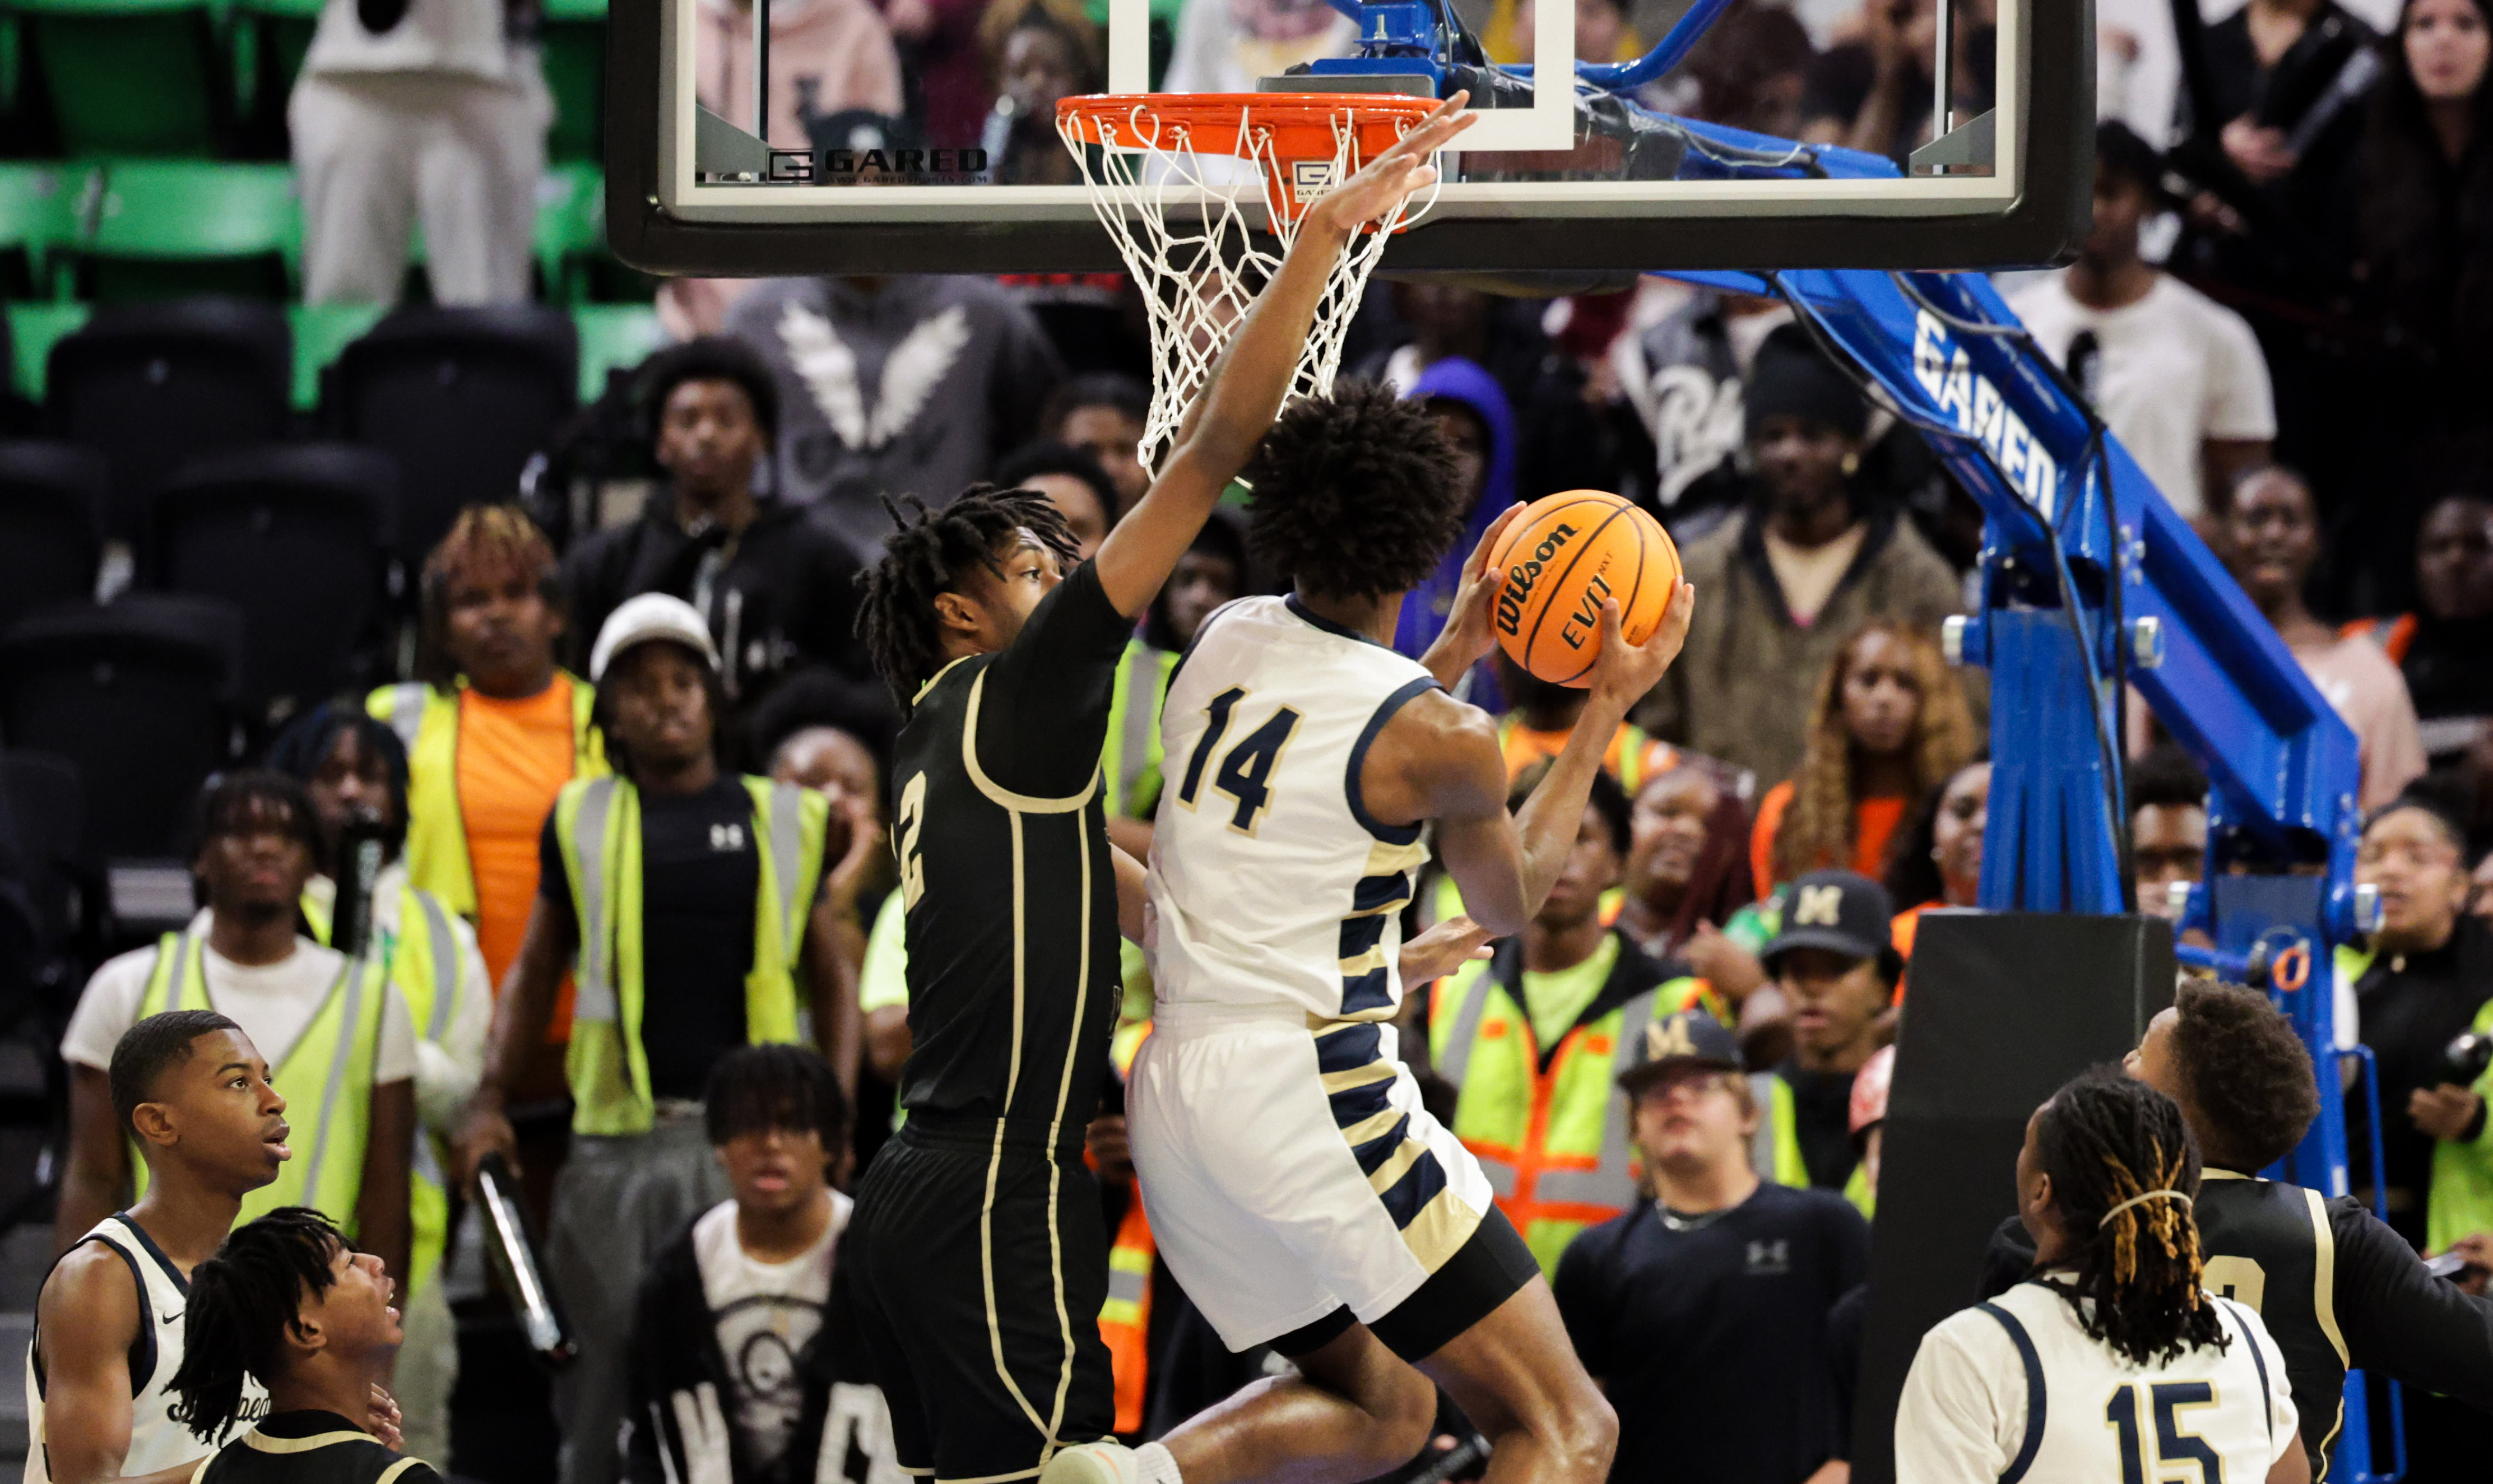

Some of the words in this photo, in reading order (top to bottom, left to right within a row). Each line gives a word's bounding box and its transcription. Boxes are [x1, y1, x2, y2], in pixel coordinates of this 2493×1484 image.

[825, 148, 987, 173] GARED
[1914, 309, 2056, 522] GARED
[1497, 523, 1577, 636] Wilson
[1176, 683, 1306, 839] 14
[1795, 884, 1844, 925] M
[1646, 1015, 1698, 1062] M
[2104, 1378, 2228, 1484] 15
